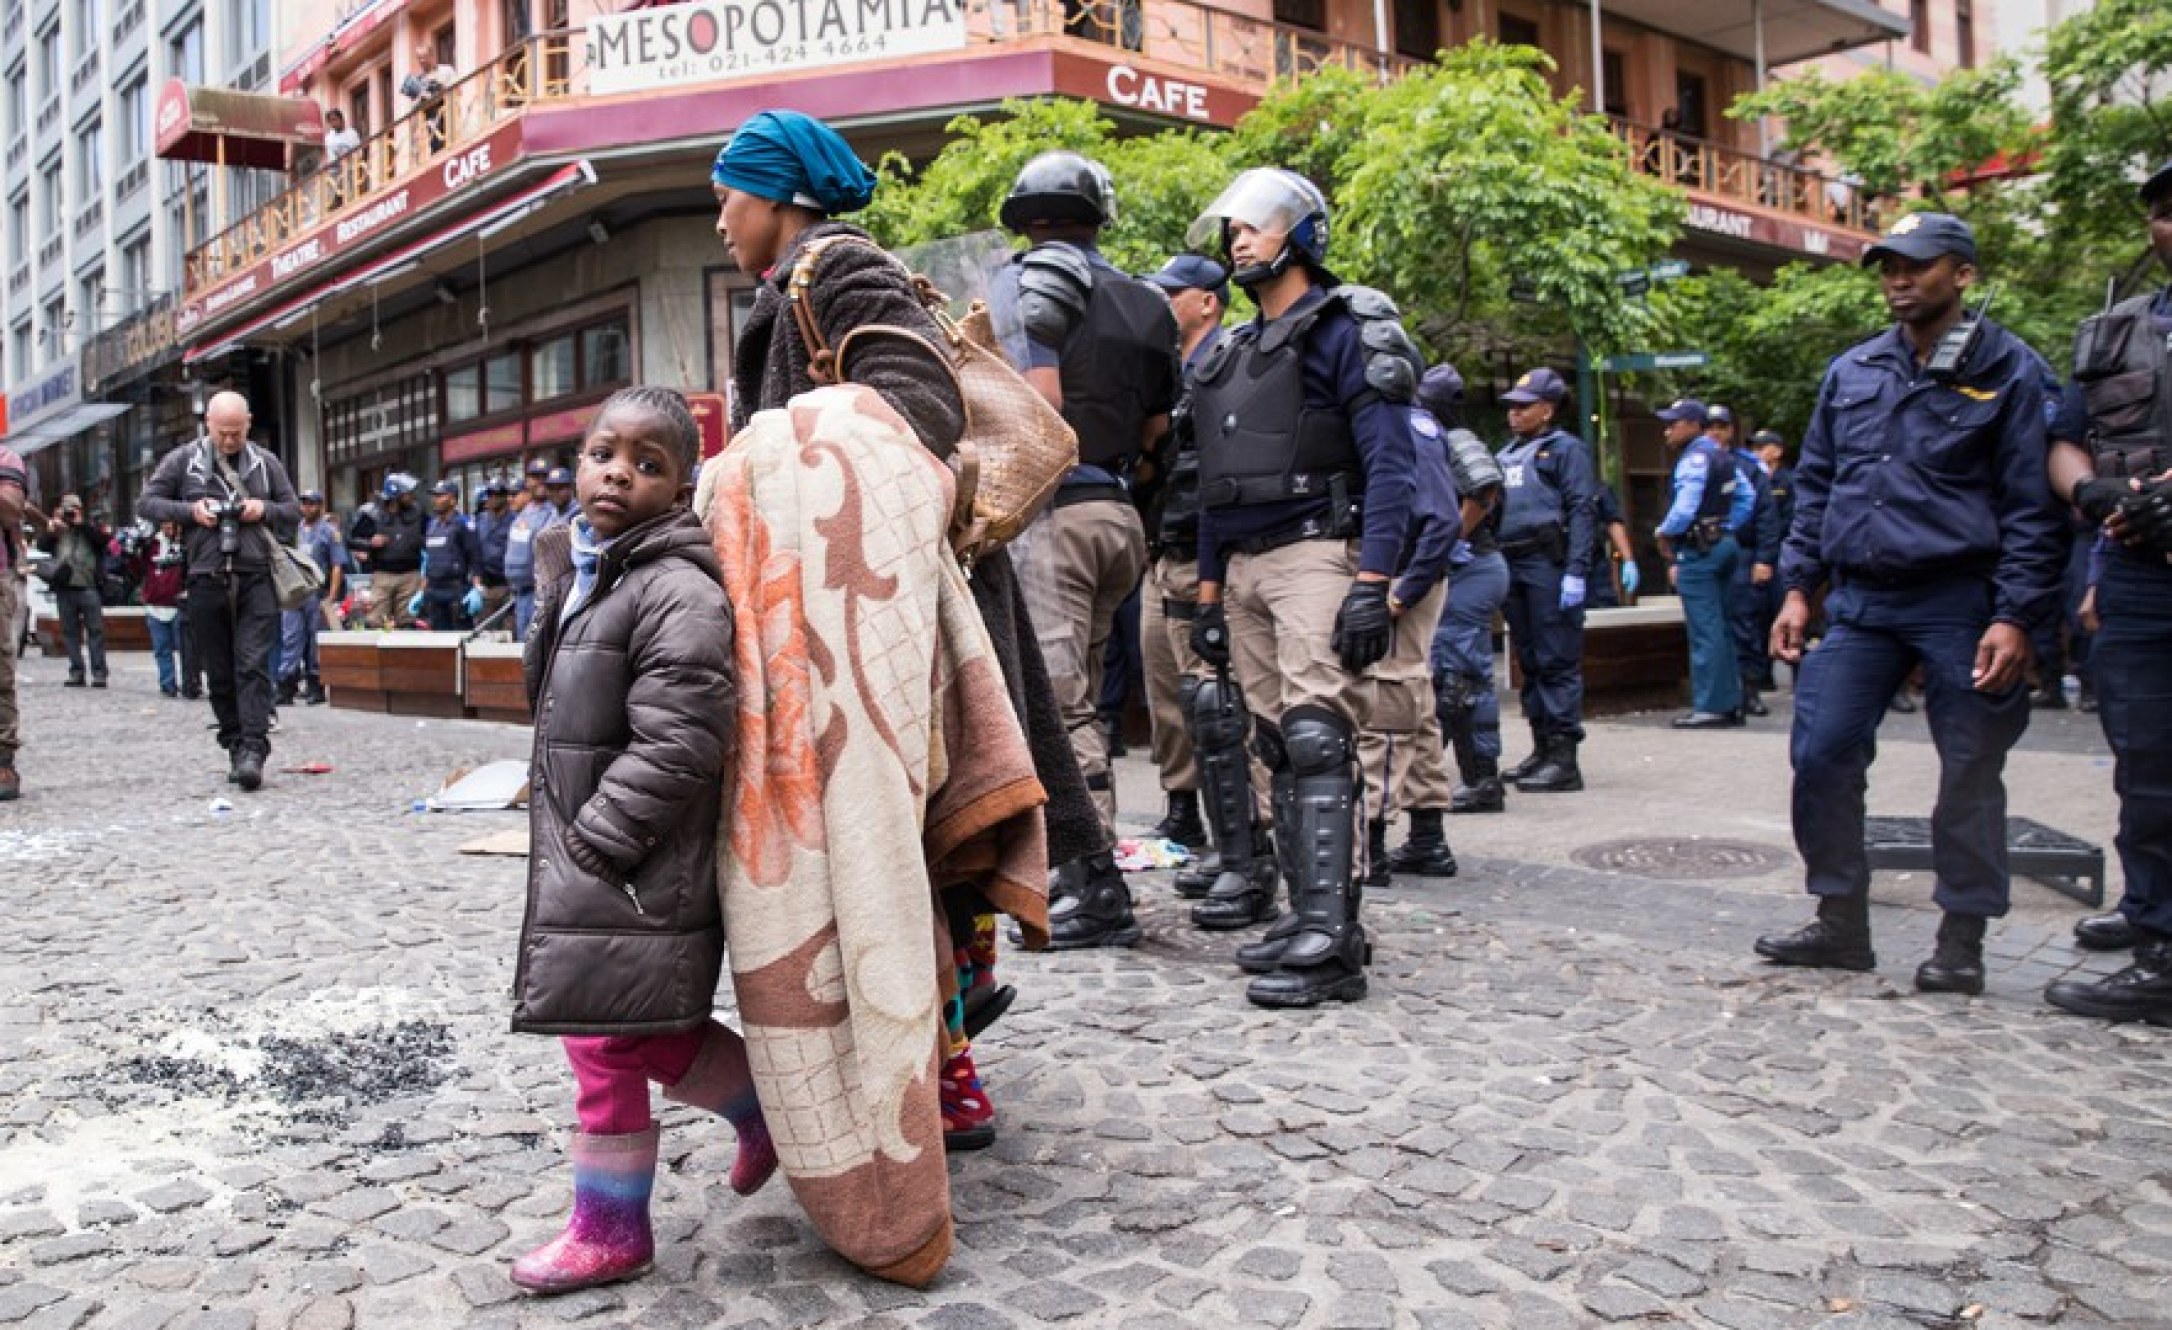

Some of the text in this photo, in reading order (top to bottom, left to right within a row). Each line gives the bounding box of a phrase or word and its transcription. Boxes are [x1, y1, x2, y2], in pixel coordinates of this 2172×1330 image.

[597, 0, 954, 70] MESOPOTAMIA
[659, 34, 887, 79] tel: 021-424 4664
[1107, 65, 1210, 119] CAFE
[443, 143, 491, 188] CAFE
